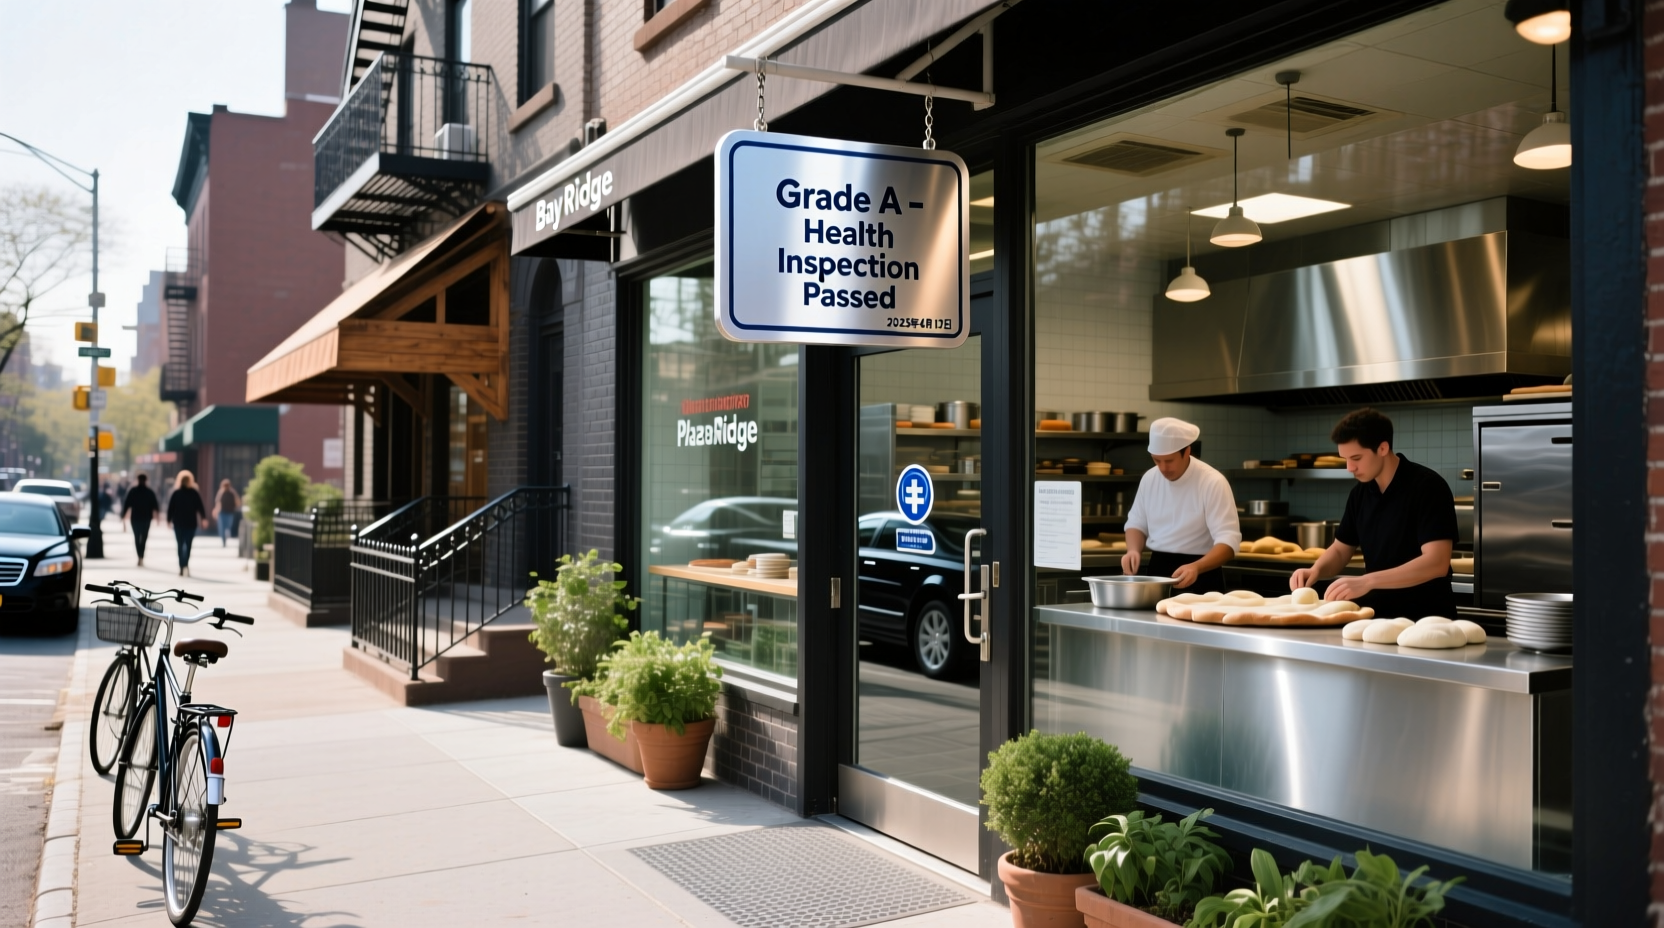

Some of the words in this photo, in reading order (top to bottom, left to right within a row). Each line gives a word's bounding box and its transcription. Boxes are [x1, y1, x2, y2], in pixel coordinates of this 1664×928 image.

[536, 199, 563, 231] Bay
[564, 170, 613, 216] Ridge
[776, 178, 871, 213] Grade
[878, 186, 902, 215] A
[804, 218, 894, 249] Health
[778, 247, 919, 282] Inspection
[803, 281, 896, 309] Passed
